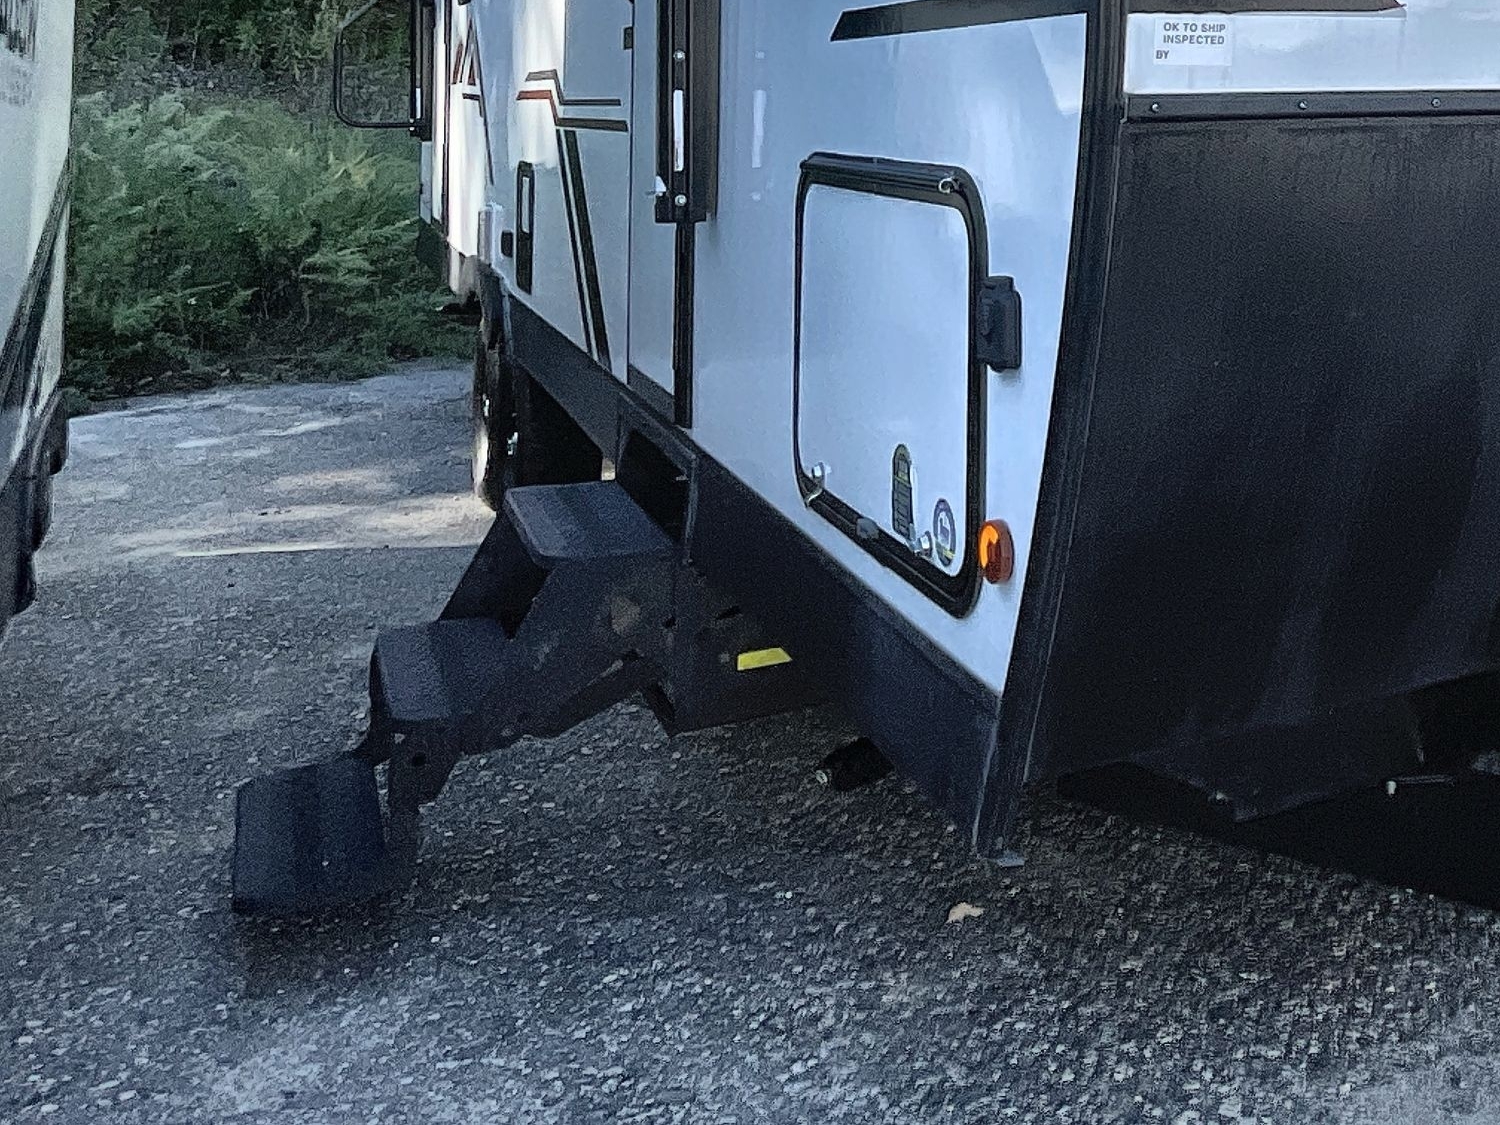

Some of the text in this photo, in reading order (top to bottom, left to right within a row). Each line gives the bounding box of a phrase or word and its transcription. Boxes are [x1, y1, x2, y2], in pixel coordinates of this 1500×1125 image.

[1163, 22, 1226, 33] OK TO SHIP
[1163, 35, 1225, 45] INSPECTED
[1155, 49, 1170, 60] BY
